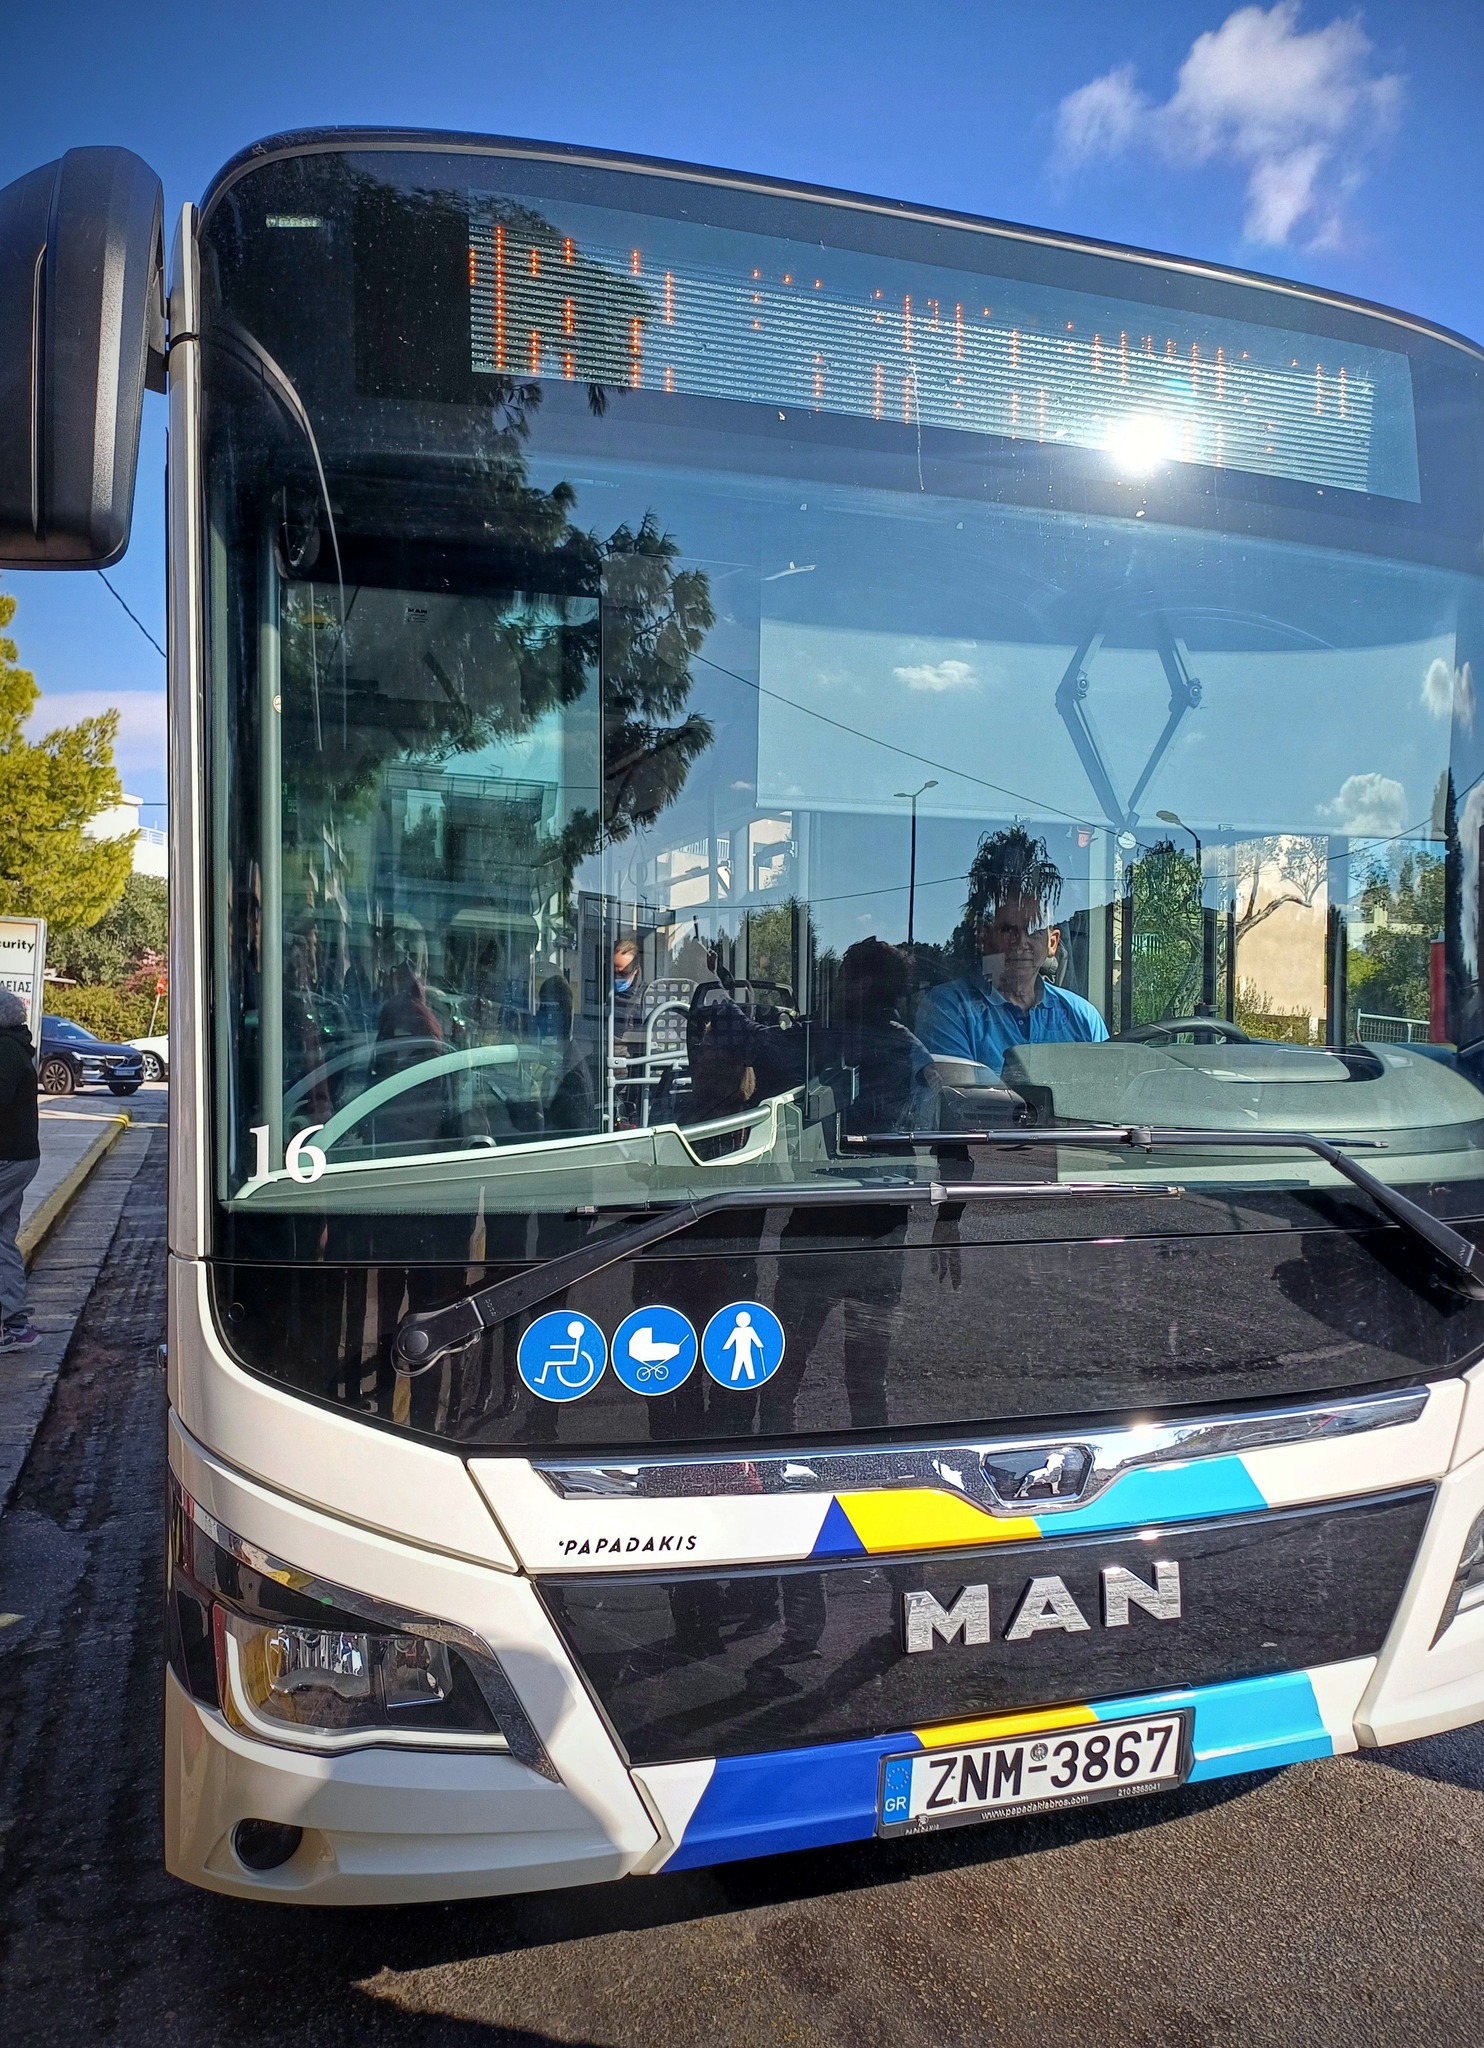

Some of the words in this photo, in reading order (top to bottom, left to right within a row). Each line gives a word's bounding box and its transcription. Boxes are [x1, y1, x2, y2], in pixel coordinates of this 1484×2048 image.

[0, 939, 35, 953] urity
[247, 1123, 327, 1184] 16
[562, 1535, 698, 1556] PAPADAKIS
[901, 1560, 1182, 1654] MAN
[926, 1724, 1174, 1810] ZNM-3867
[884, 1796, 907, 1812] GR
[980, 1794, 1089, 1820] www.papadakisbros.com
